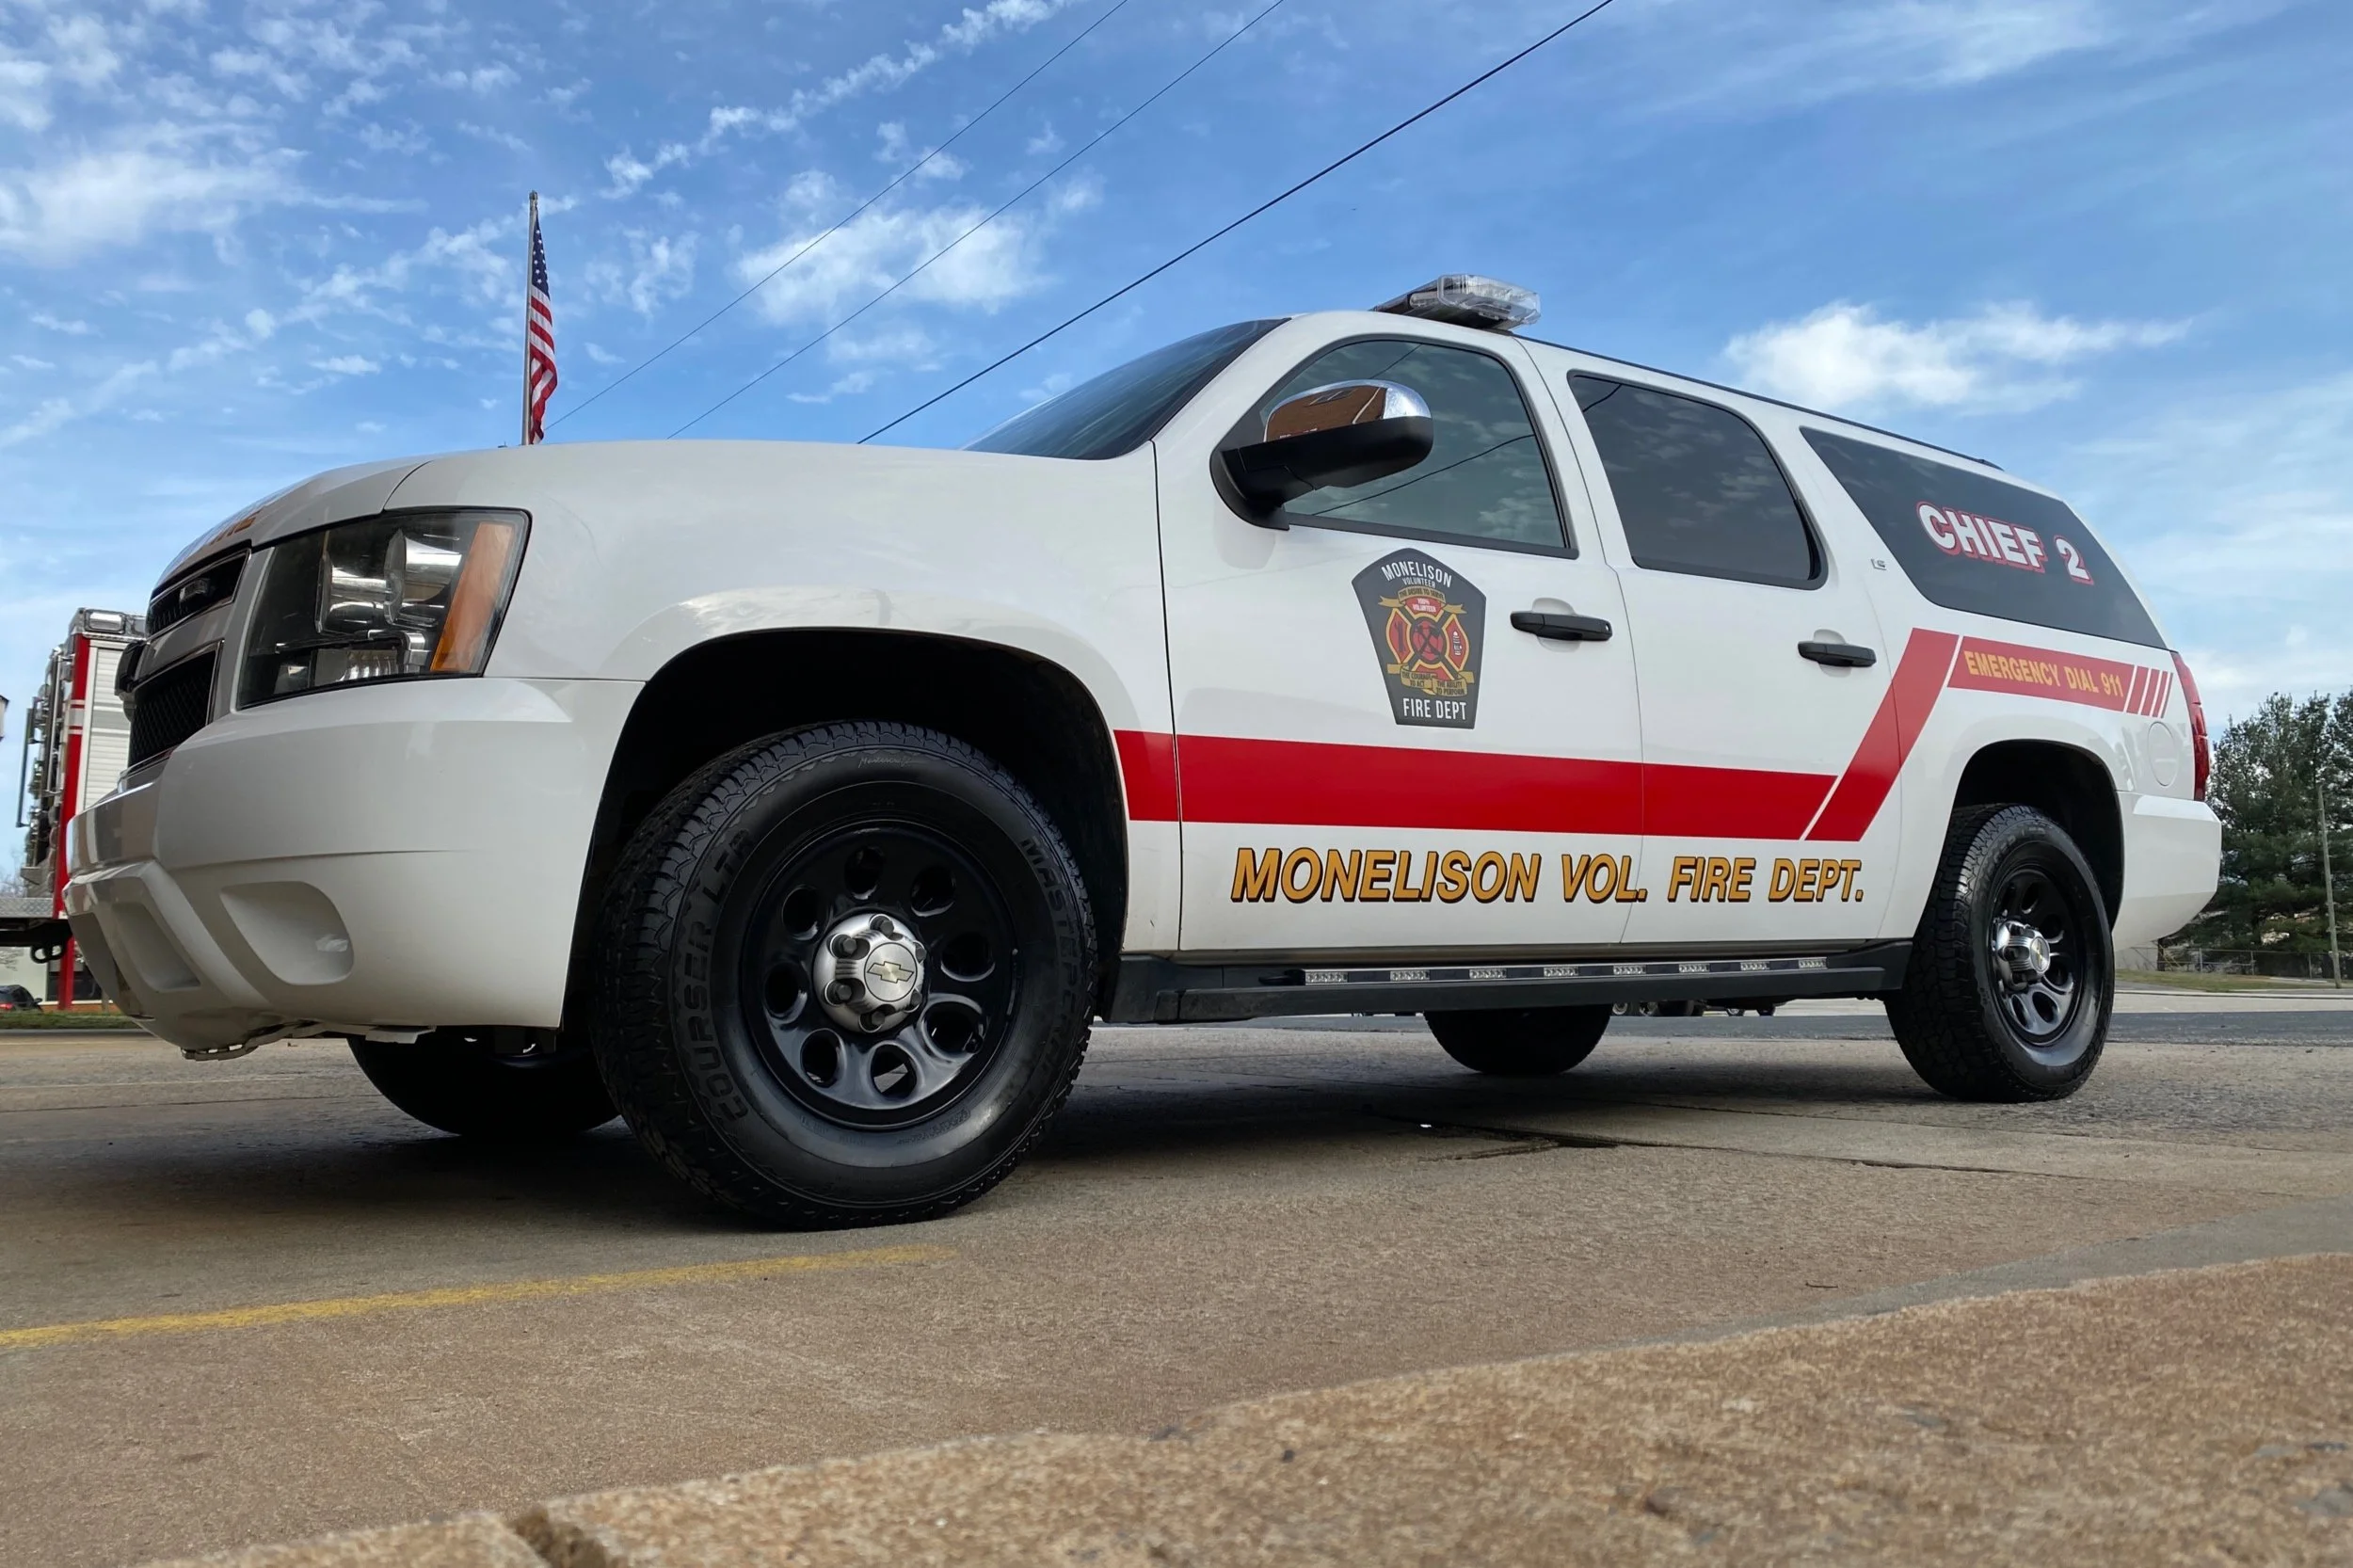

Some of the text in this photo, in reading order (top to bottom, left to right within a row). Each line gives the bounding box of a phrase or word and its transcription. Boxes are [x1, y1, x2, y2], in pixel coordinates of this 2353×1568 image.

[1916, 501, 2094, 585] CHIEF 2
[1381, 561, 1452, 588] MONELISON
[1401, 577, 1436, 589] VOLUNTEER
[1963, 650, 2124, 697] EMERGENCY DIAL 911
[1402, 697, 1466, 720] FIRE DEPT
[1230, 847, 1864, 904] MONELISON VOL. FIRE DEPT.
[683, 920, 749, 1123] COURSER
